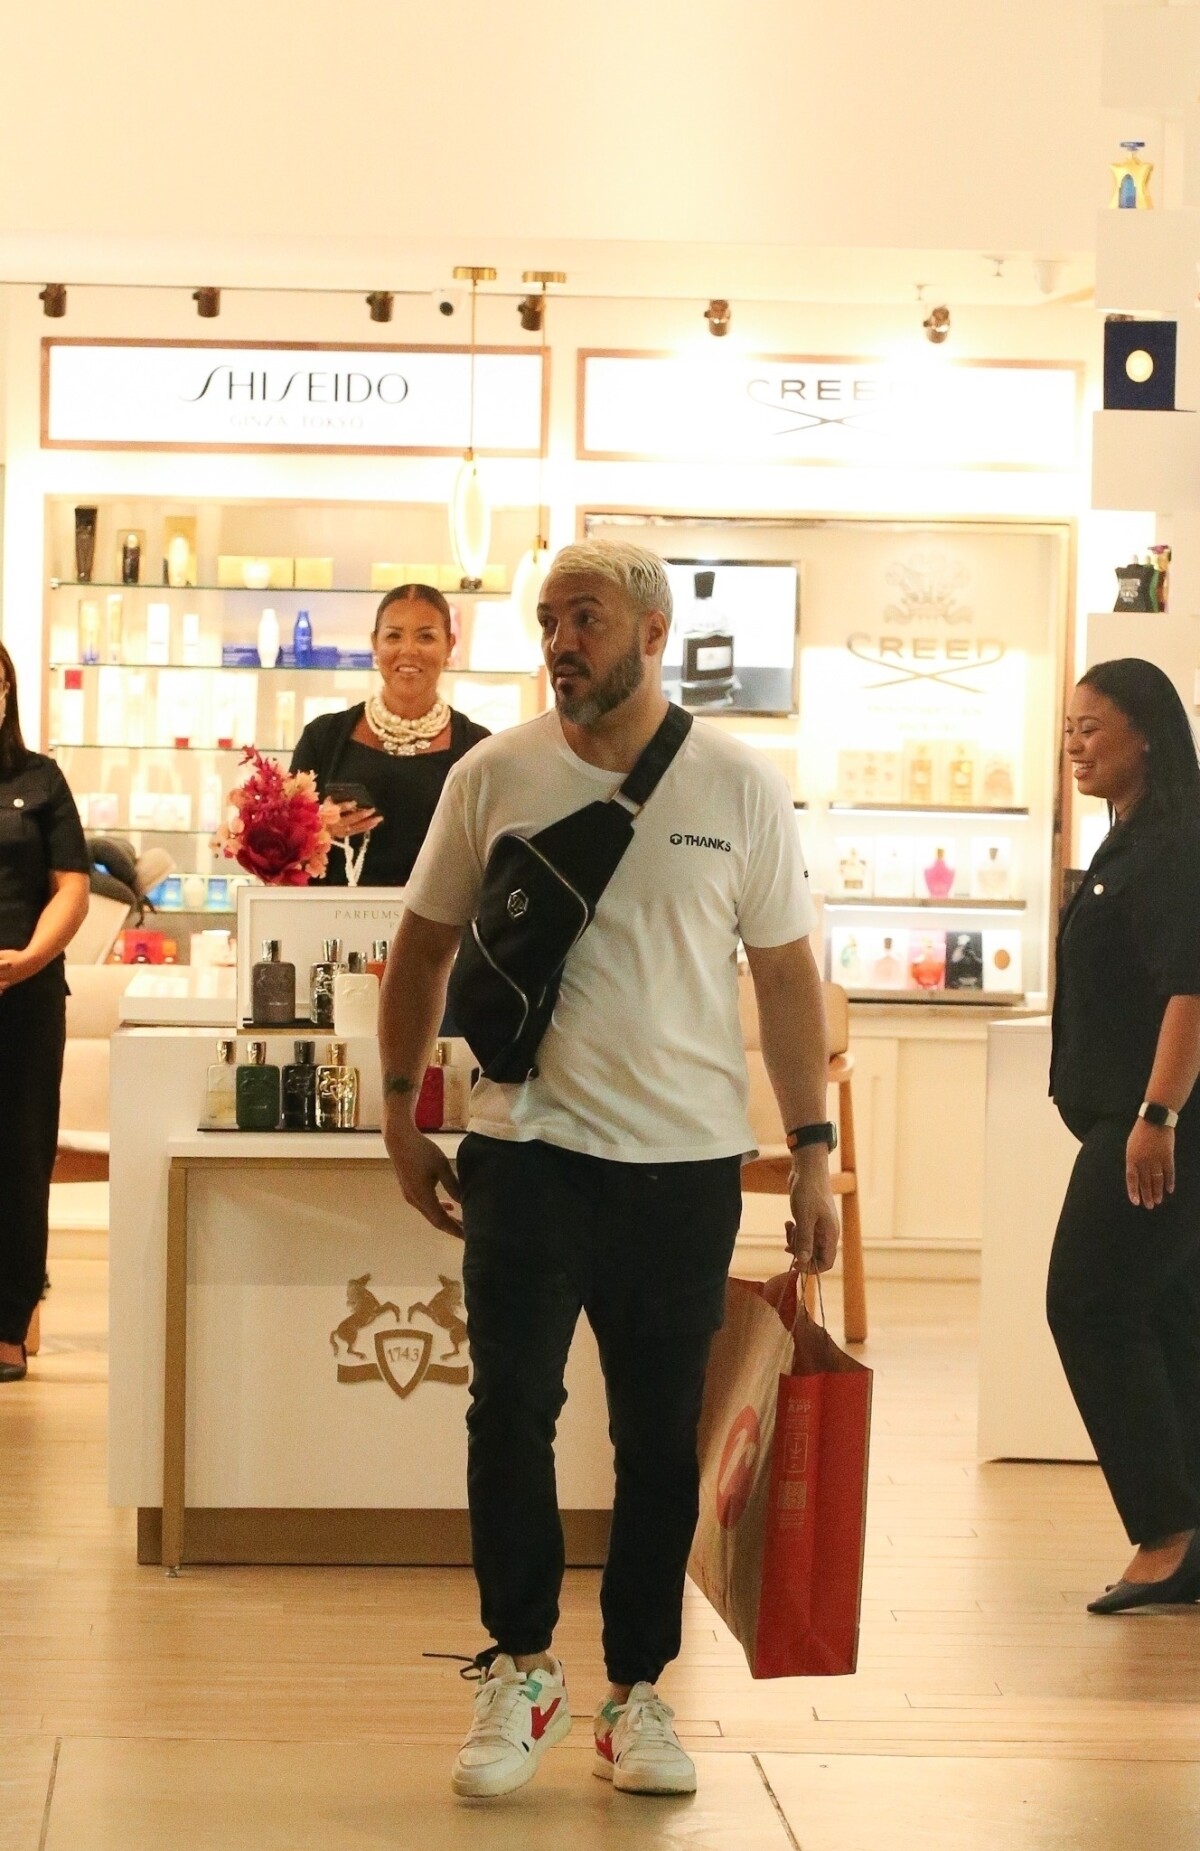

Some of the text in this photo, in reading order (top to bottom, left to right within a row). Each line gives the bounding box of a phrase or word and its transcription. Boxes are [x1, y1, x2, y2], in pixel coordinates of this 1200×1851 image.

[178, 365, 409, 404] SHISEIDO
[229, 414, 363, 429] GINZA TOKYO
[846, 631, 1005, 660] CREED
[684, 834, 732, 852] THANKS
[334, 909, 400, 920] PARFUMS
[387, 1346, 419, 1362] 1743
